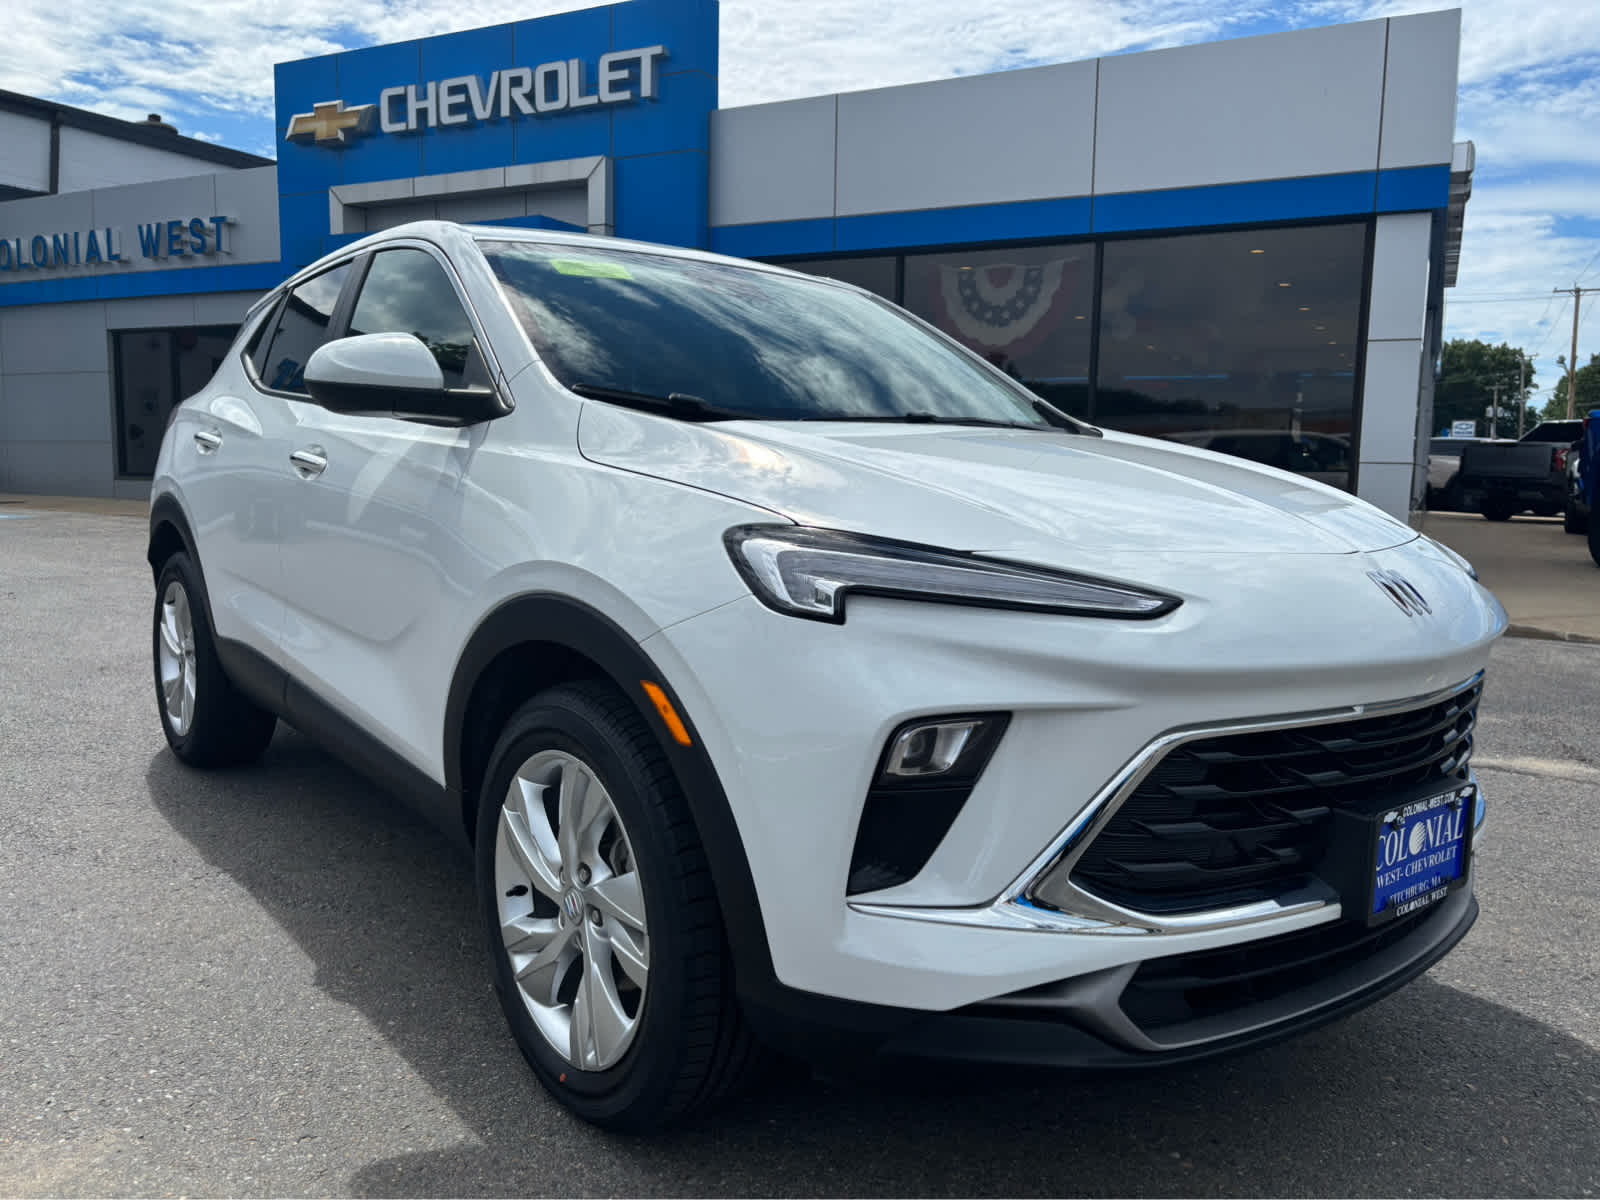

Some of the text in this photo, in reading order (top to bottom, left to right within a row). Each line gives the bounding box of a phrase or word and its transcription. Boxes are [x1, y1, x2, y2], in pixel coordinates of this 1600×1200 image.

[379, 45, 667, 134] CHEVROLET
[137, 215, 228, 259] WEST
[1396, 886, 1449, 917] COLONIAL WEST
